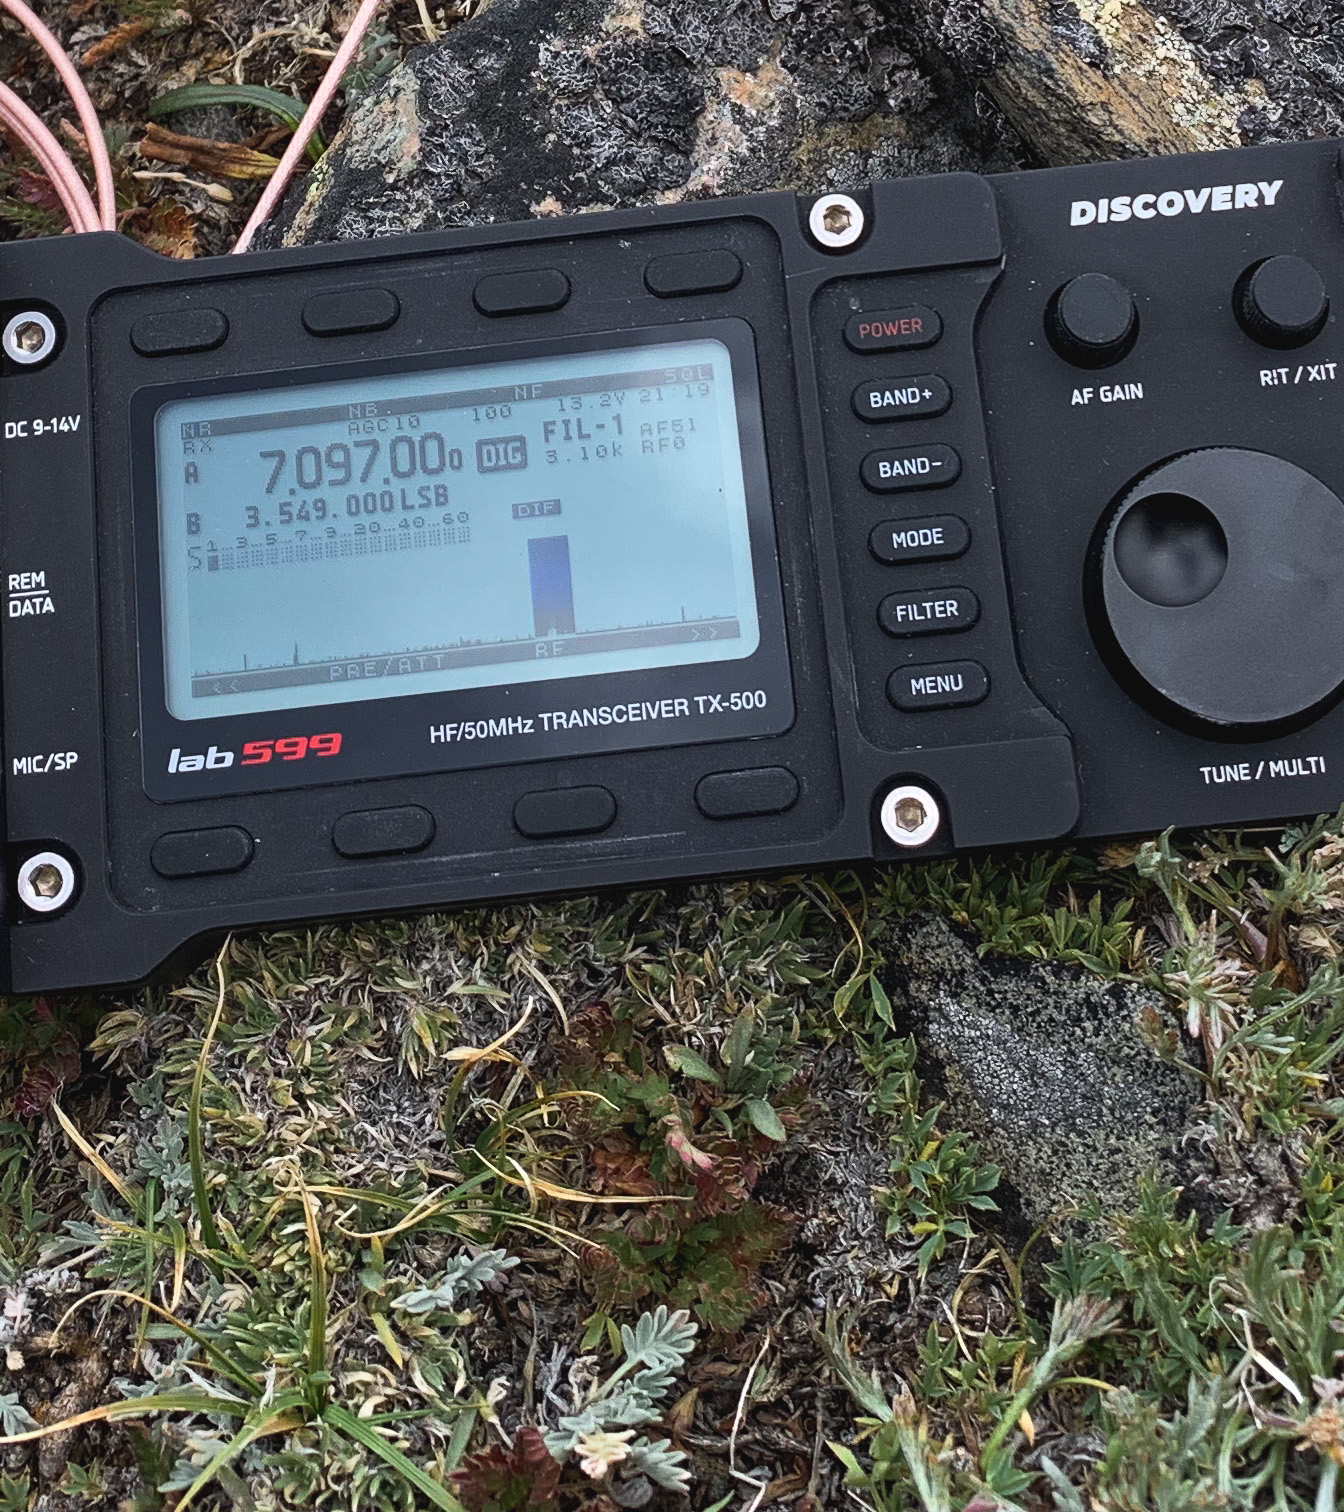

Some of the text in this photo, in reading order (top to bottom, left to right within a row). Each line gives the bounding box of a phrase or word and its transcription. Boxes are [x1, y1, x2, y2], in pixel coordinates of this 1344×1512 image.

[1069, 179, 1284, 227] DISCOVERY
[859, 318, 923, 339] POWER
[1259, 363, 1337, 386] RIT / XIT
[348, 404, 378, 418] NB
[513, 384, 544, 400] NF
[664, 367, 712, 382] SQL
[870, 387, 932, 408] BAND+
[1070, 383, 1144, 406] AF GAIN
[5, 415, 81, 439] DC 9-14V
[183, 441, 213, 455] RX
[473, 405, 512, 421] 100
[184, 462, 199, 484] A
[482, 442, 523, 468] DIG
[543, 413, 623, 443] FIL-1
[517, 501, 555, 518] DIF
[187, 512, 200, 534] B
[892, 528, 944, 549] MODE
[8, 571, 46, 591] REM
[8, 596, 55, 618] DATA
[896, 600, 959, 622] FILTER
[329, 640, 564, 681] PRE/ATT RF
[911, 674, 963, 696] MENU
[429, 691, 767, 744] HF/50MHz TRANSCEIVER TX-500
[13, 752, 79, 776] MIC/SP
[1200, 755, 1326, 786] TUNE / MULTI
